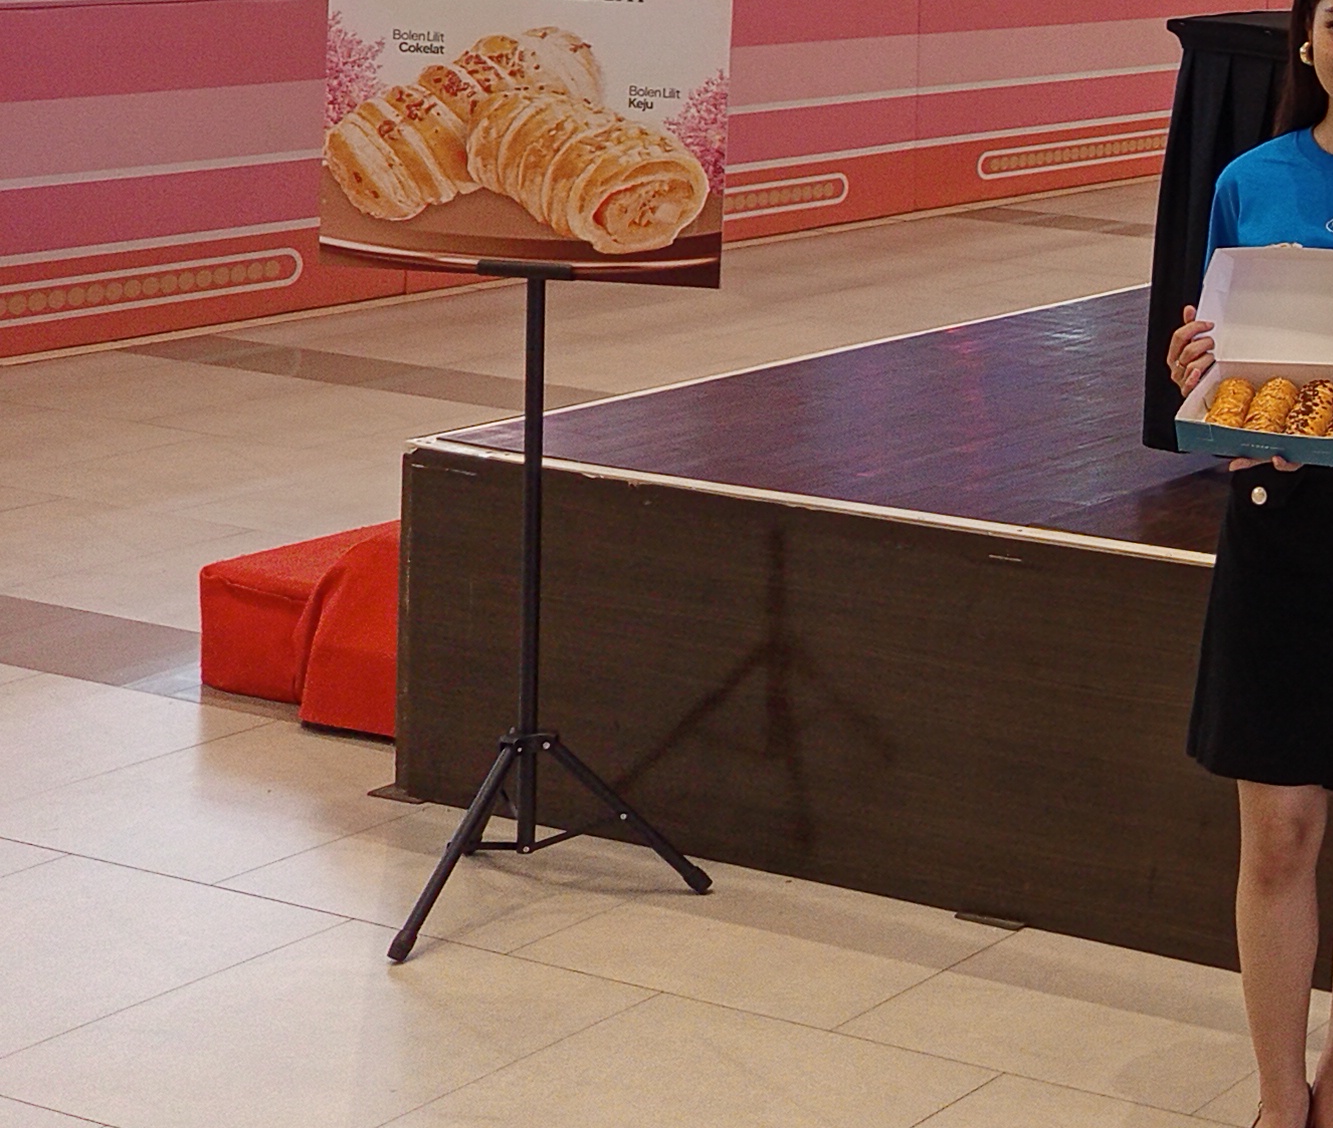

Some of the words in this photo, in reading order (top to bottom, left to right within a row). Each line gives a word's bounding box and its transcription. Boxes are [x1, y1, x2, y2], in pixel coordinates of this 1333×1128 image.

[392, 28, 426, 41] Bolen
[398, 42, 445, 55] Cokelat
[629, 84, 662, 98] Bolen
[628, 97, 654, 112] Keju
